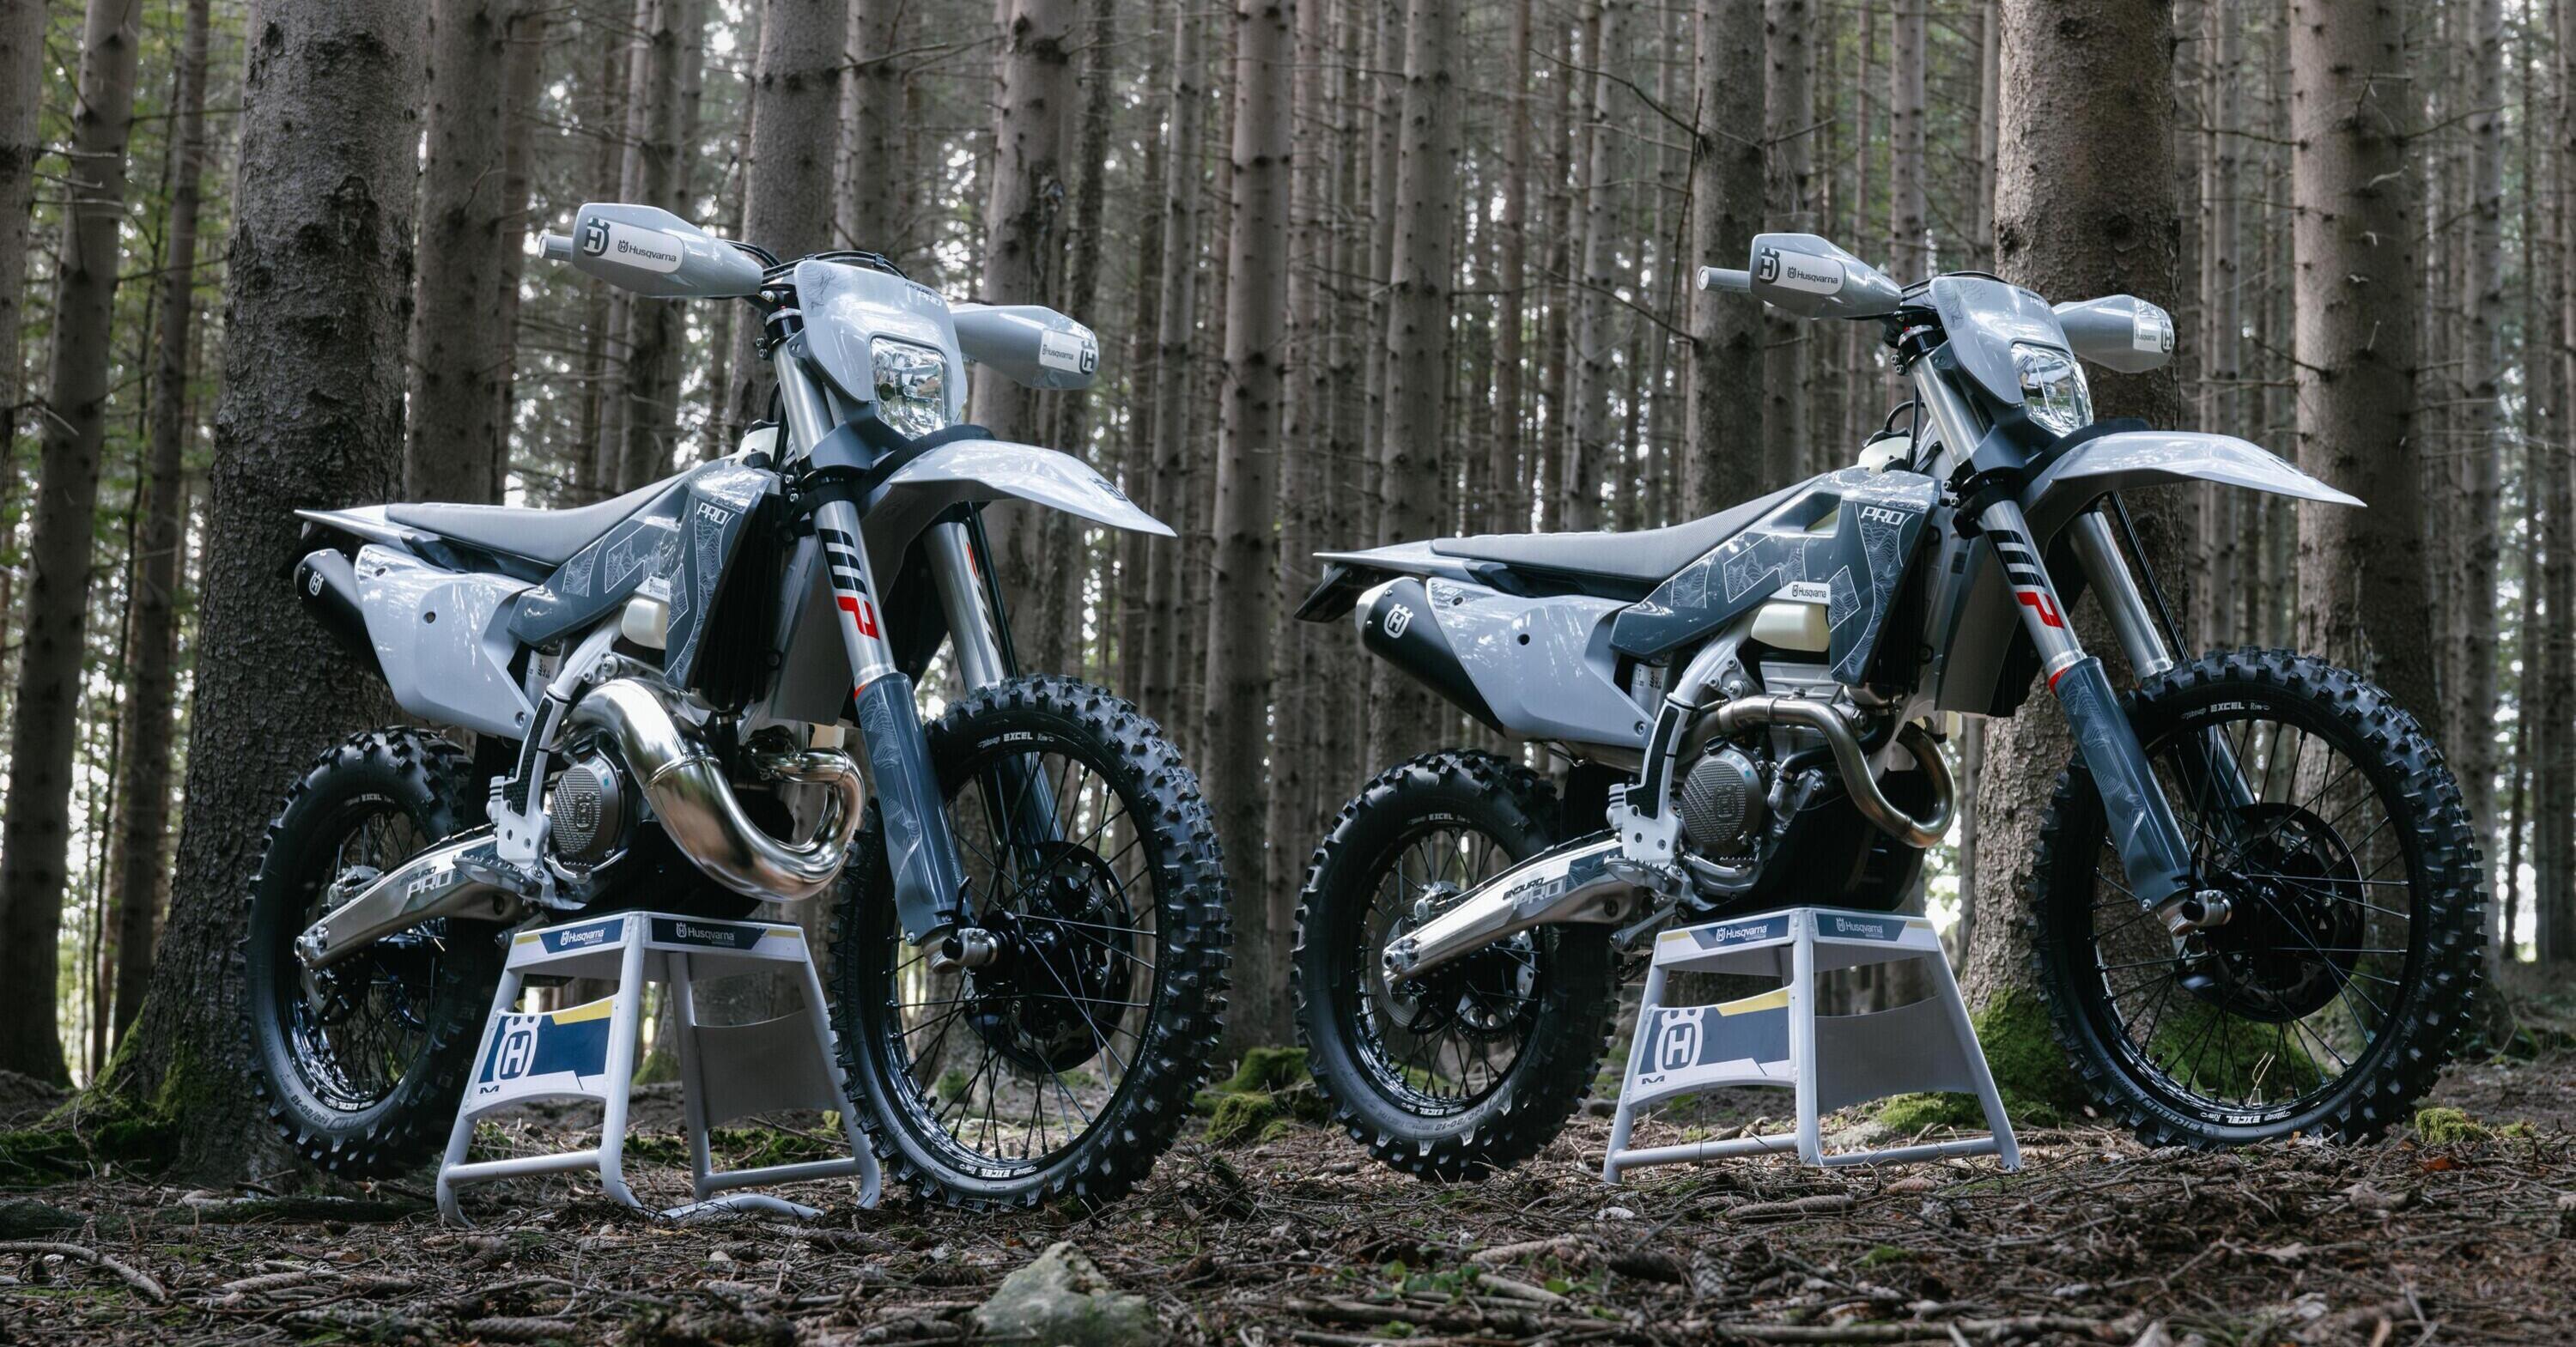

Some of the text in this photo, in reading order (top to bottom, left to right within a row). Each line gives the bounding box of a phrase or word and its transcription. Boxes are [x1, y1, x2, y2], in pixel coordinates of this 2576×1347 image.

[629, 245, 677, 262] Husqvarna
[1796, 270, 1838, 284] Husqvarna
[696, 501, 729, 525] PRO
[1860, 506, 1906, 525] PRO
[1798, 586, 1827, 598] Husqvarna
[2210, 701, 2245, 713] EXCEL
[1003, 731, 1034, 743] EXCEL
[406, 869, 454, 901] PRO
[1502, 876, 1545, 901] ENDURO
[1512, 878, 1564, 911] PRO
[688, 926, 735, 941] Husqvarna
[1725, 925, 1767, 940] Husqvarna
[1845, 920, 1883, 934] Husqvarna
[568, 929, 605, 944] Husqvarna
[1419, 1107, 1444, 1116] EXCEL
[2142, 1099, 2205, 1133] MICHELIN
[2208, 1113, 2221, 1123] Rim
[2226, 1114, 2261, 1125] EXCEL
[981, 1168, 1011, 1178] EXCEL
